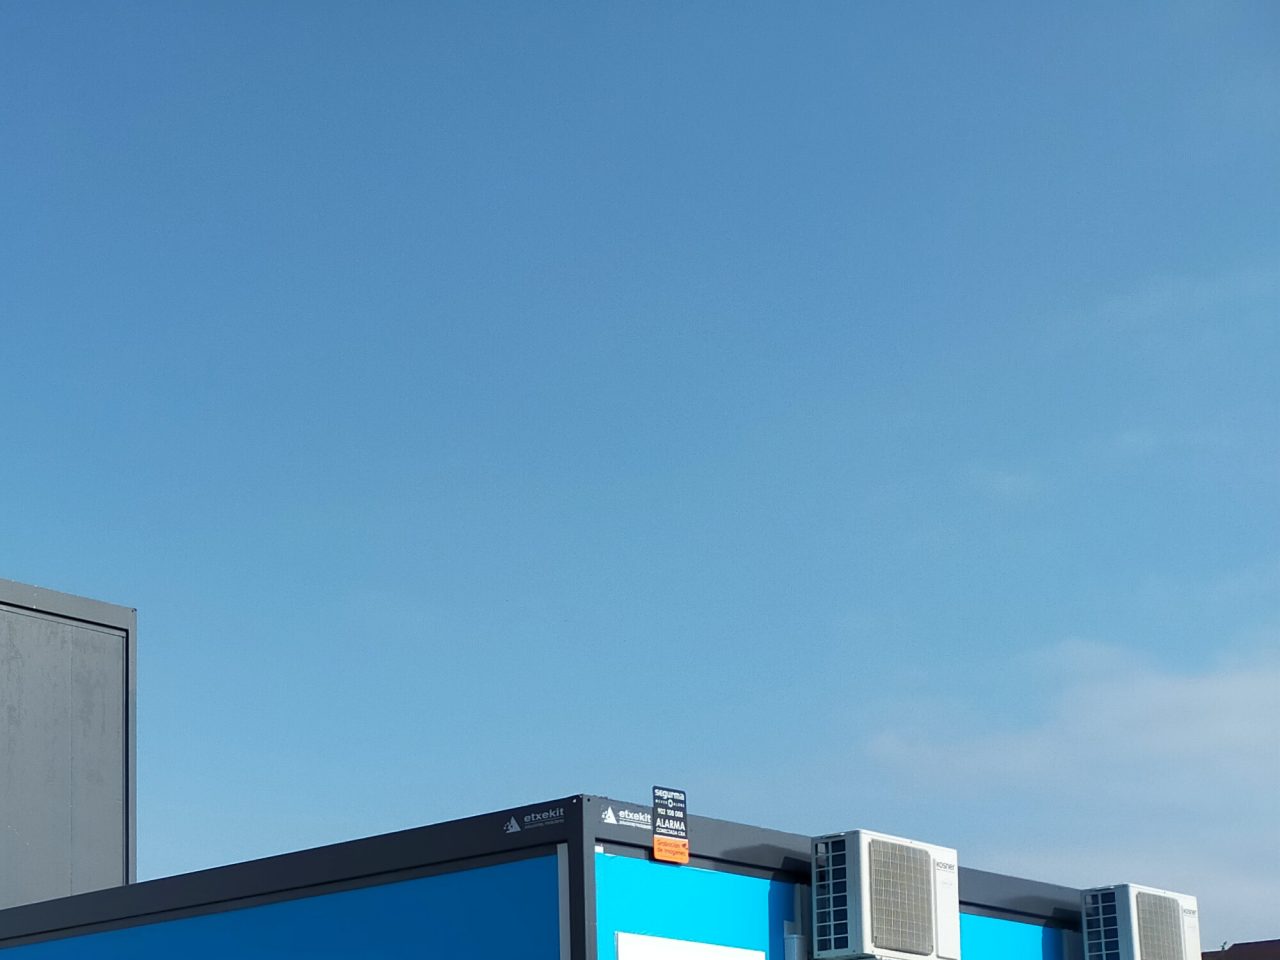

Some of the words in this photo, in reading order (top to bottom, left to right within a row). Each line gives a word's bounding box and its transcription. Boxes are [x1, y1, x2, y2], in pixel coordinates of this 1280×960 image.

[654, 789, 685, 801] segurma
[523, 807, 564, 823] etxekit
[618, 809, 651, 823] etxekit
[656, 818, 686, 831] ALARMA
